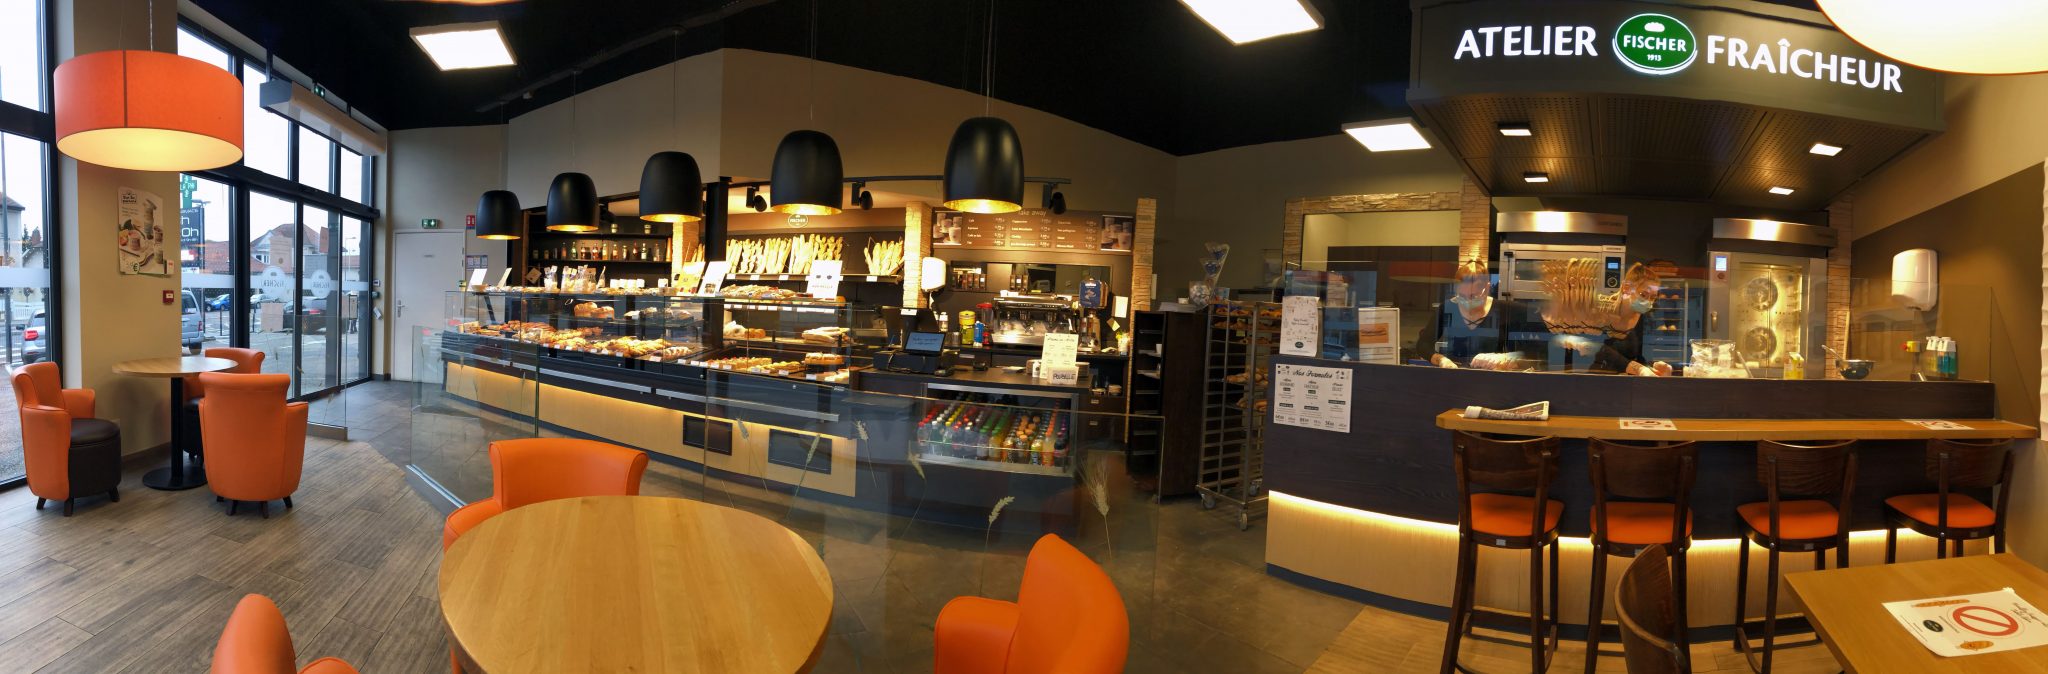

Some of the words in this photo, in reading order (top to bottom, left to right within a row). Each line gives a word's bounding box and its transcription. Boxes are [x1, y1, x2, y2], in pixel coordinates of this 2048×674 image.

[1453, 25, 1598, 60] ATELIER
[1623, 34, 1687, 52] FISCHER
[1647, 53, 1662, 62] 1913
[1707, 34, 1903, 93] FRAÎCHEUR
